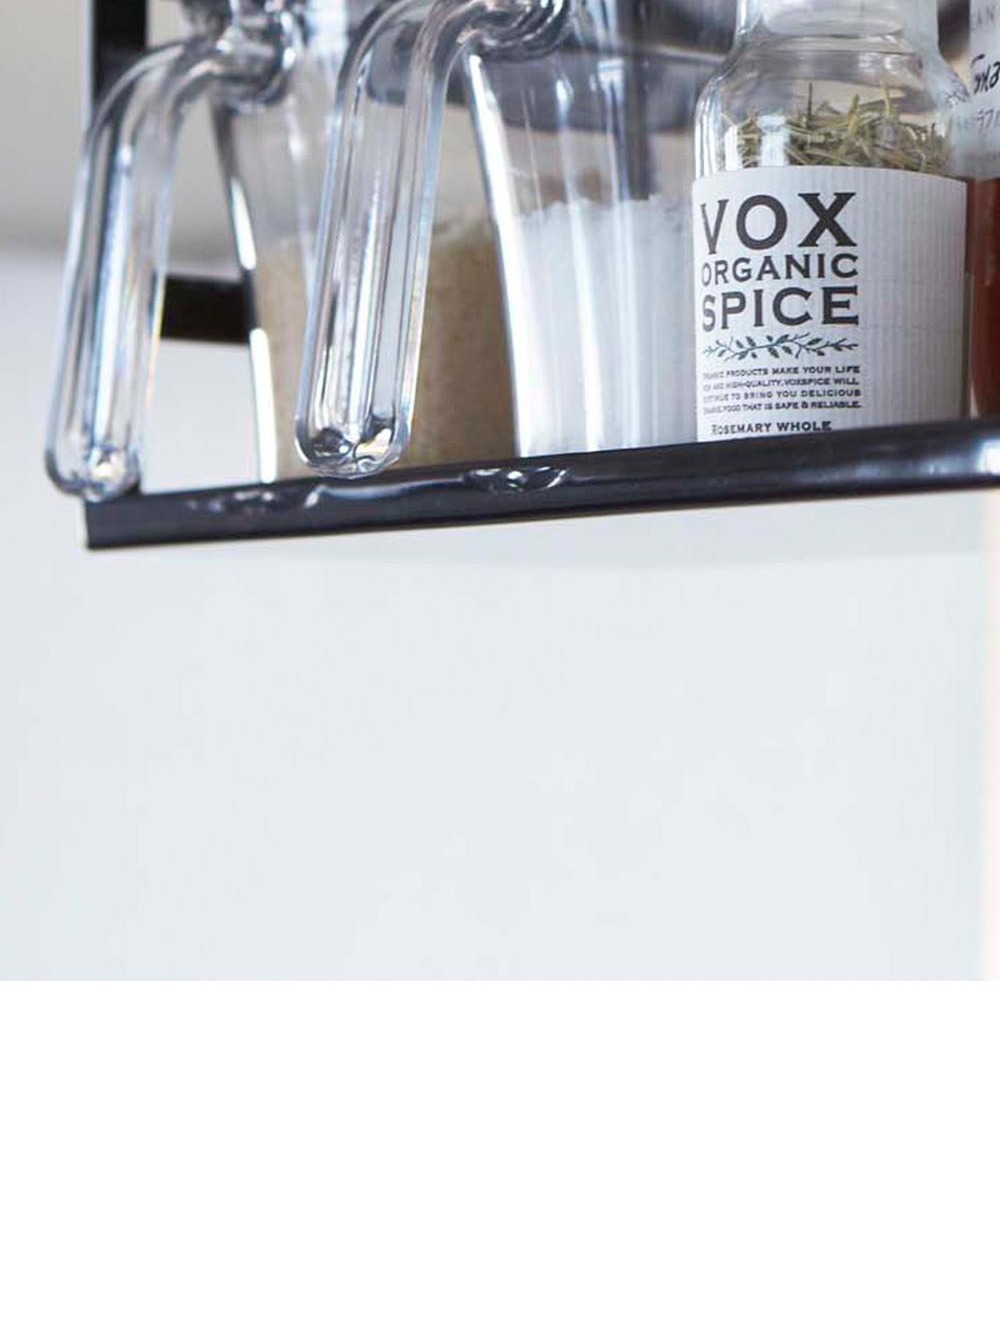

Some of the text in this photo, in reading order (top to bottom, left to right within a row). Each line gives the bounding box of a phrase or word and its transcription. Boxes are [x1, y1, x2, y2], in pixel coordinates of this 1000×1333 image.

[700, 191, 858, 255] VOX
[701, 253, 859, 286] ORGANIC
[702, 284, 859, 333] SPICE
[726, 367, 769, 377] PRODUCTS
[772, 366, 799, 375] MAKE
[802, 365, 832, 374] YOUR
[835, 365, 860, 373] LIFE
[833, 377, 859, 385] WILL
[743, 391, 773, 399] BRING
[776, 389, 798, 398] YOU
[801, 388, 861, 397] DELICIOUS
[742, 402, 762, 411] THAT
[774, 400, 799, 410] SAFE
[712, 420, 833, 436] ROSEMARY WHOLE
